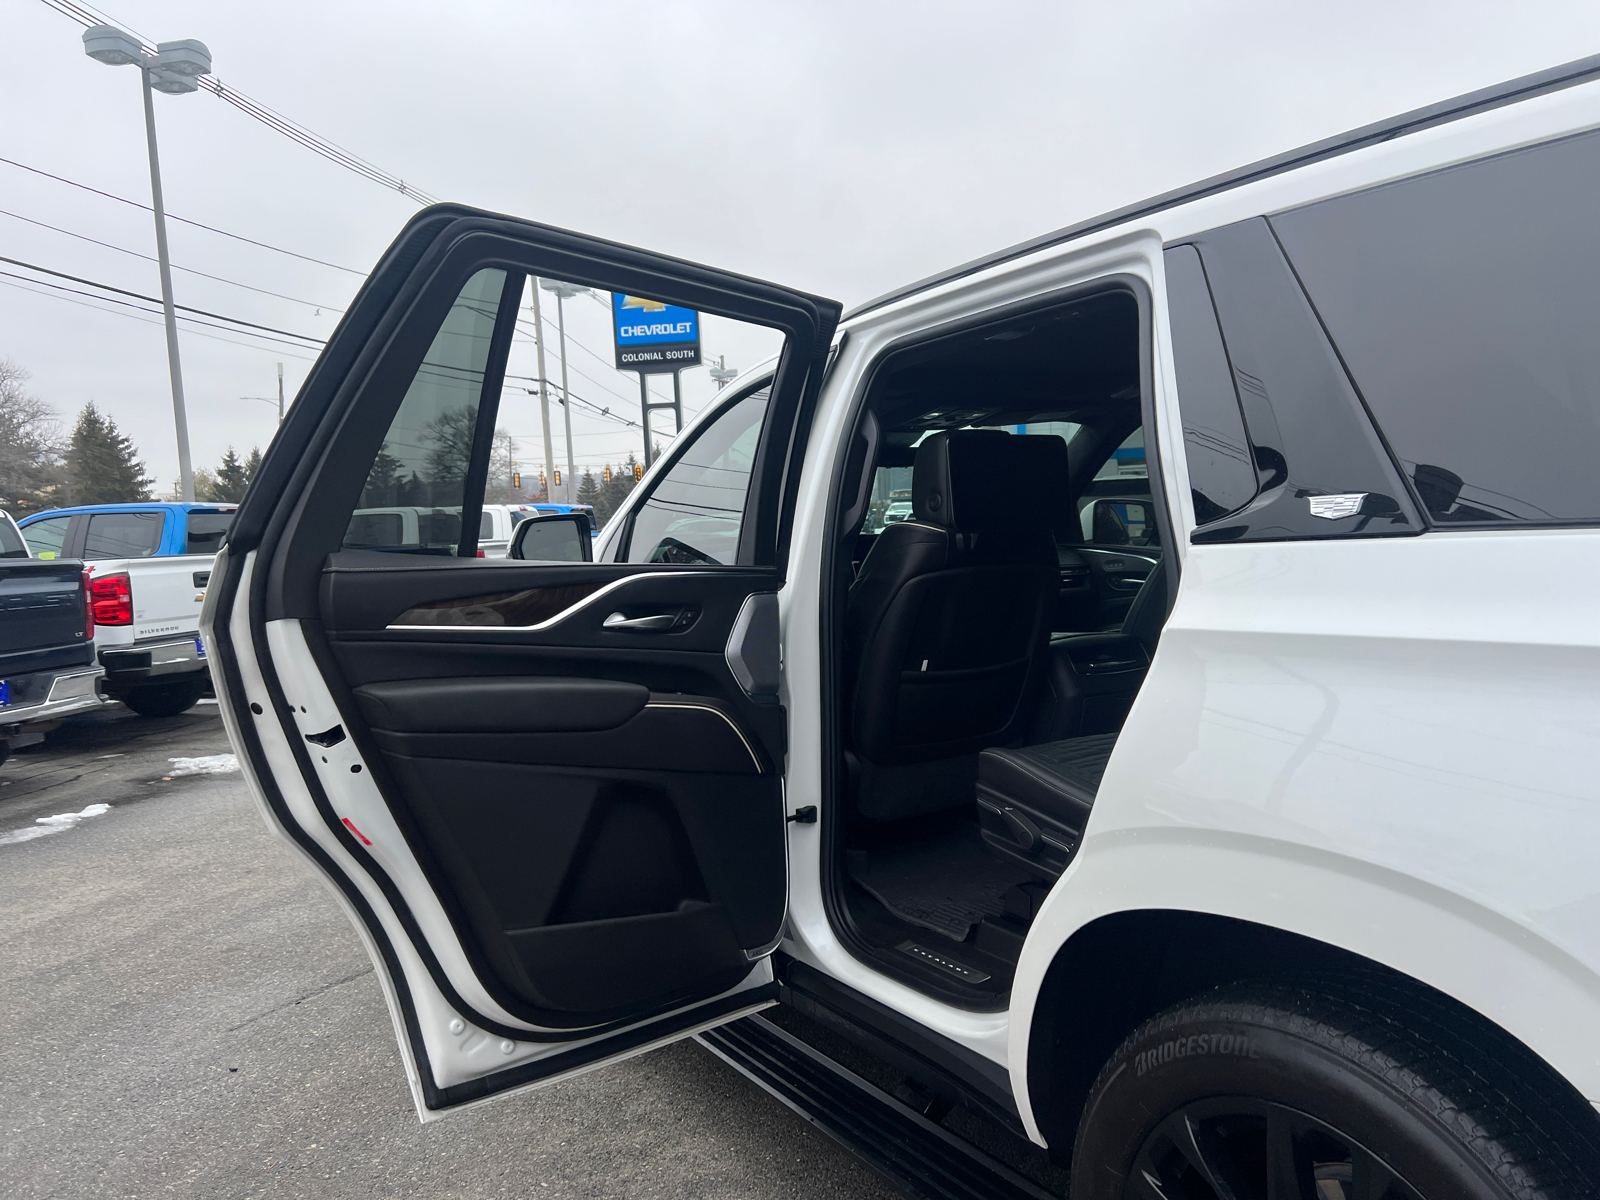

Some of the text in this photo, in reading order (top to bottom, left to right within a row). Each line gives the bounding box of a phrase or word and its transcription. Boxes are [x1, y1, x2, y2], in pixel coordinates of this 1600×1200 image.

[620, 322, 692, 337] CHEVROLET
[622, 350, 695, 362] COLONIAL SOUTH
[1134, 1034, 1260, 1077] BRIDGESTONE
